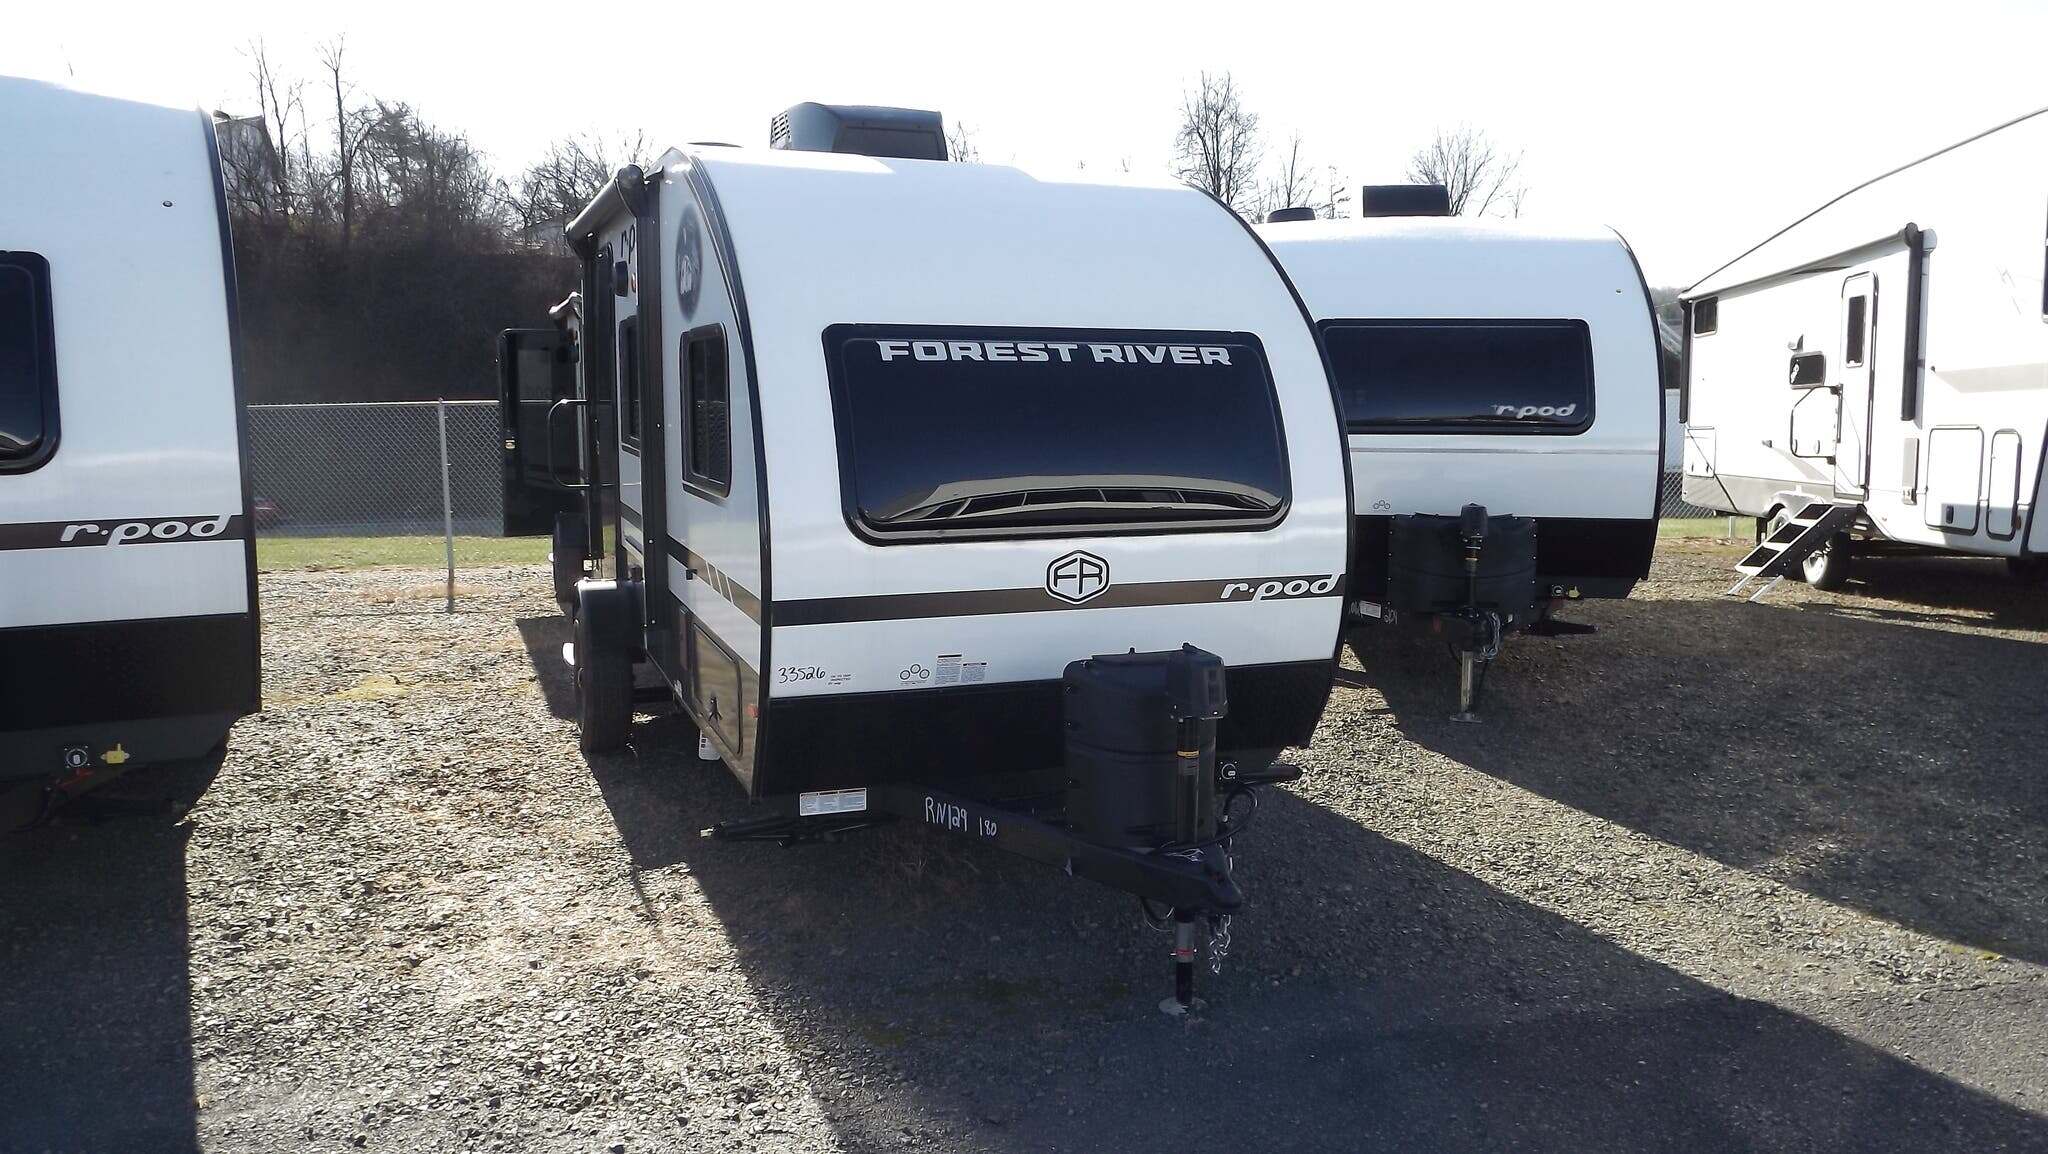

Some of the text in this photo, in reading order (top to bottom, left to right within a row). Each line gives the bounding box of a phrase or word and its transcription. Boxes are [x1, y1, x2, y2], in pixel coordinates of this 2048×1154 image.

[875, 340, 1233, 366] FOREST RIVER
[778, 666, 826, 684] 33526
